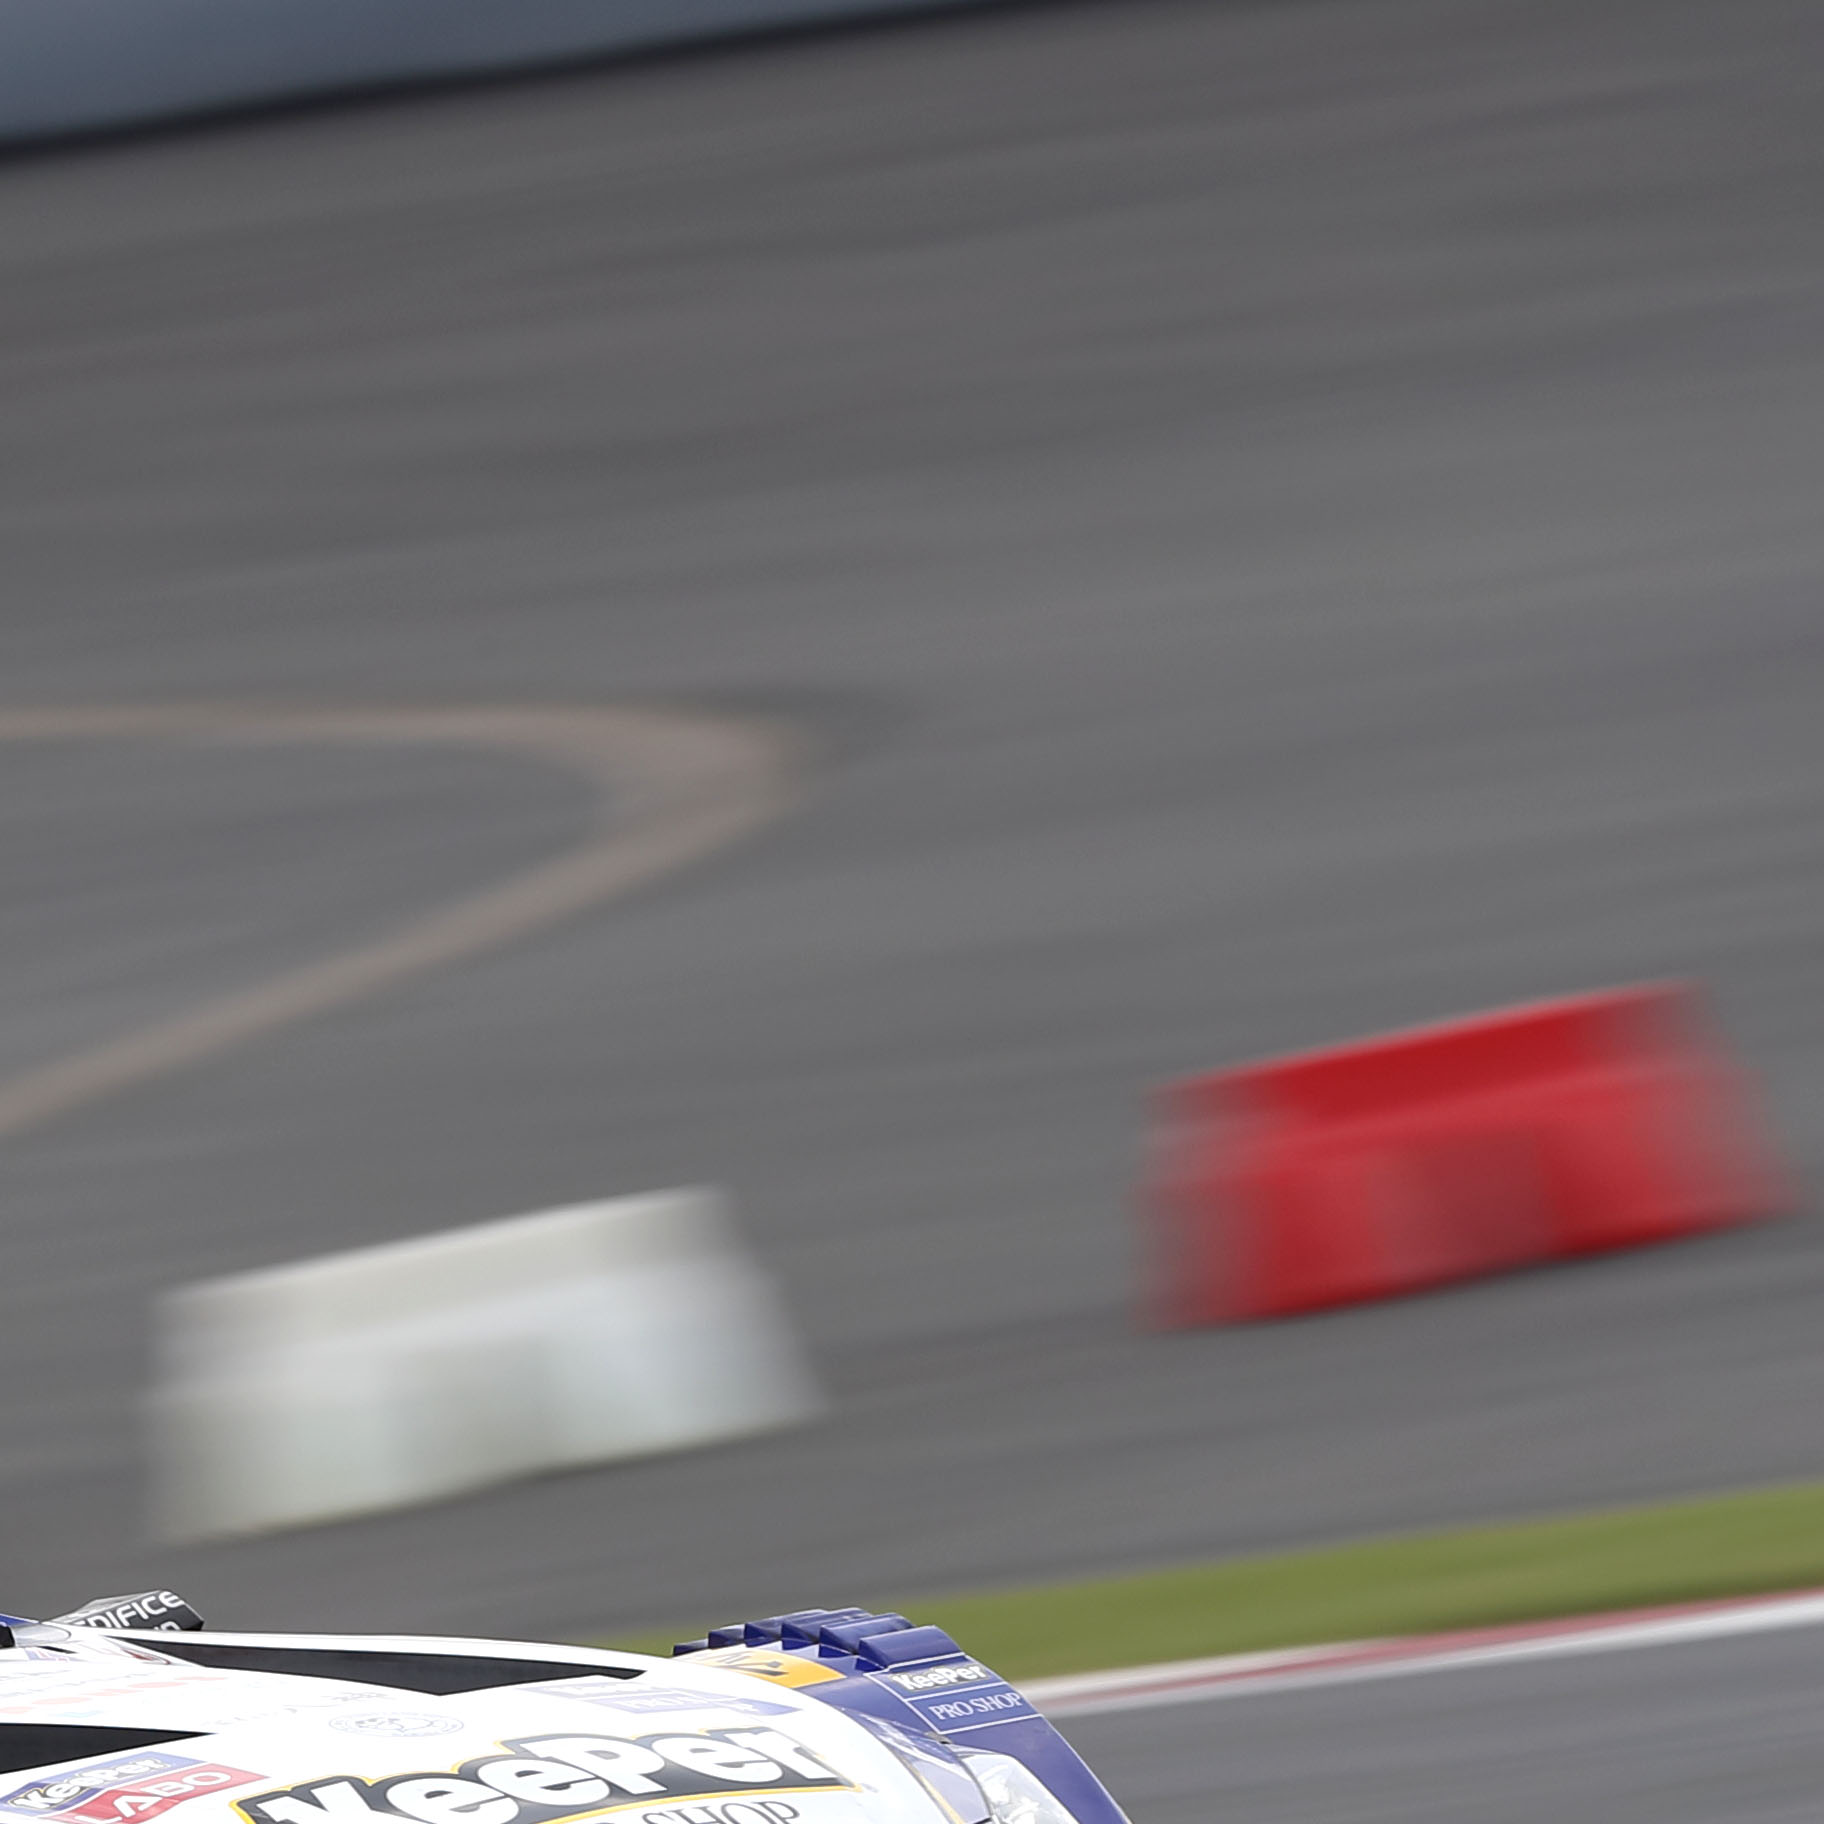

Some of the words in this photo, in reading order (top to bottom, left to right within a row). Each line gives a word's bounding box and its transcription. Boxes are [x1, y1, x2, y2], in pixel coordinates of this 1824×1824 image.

[892, 1664, 987, 1692] KeePer
[929, 1698, 973, 1722] PRO
[972, 1690, 1023, 1715] SHOP
[8, 1758, 172, 1809] KeePer
[75, 1771, 232, 1824] LABO
